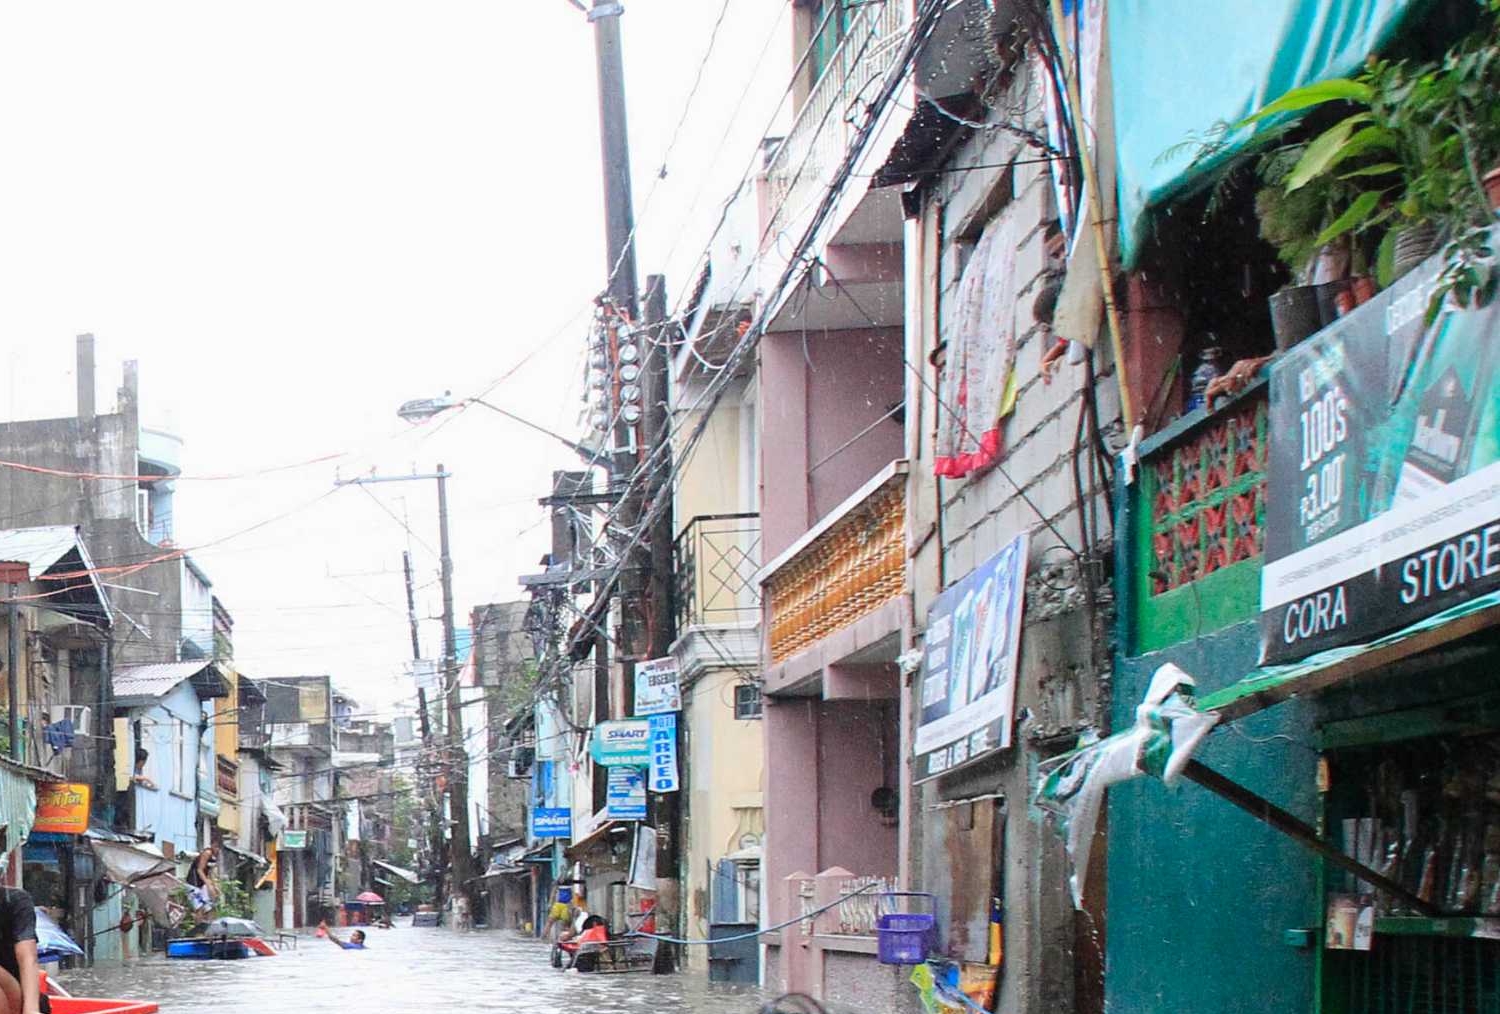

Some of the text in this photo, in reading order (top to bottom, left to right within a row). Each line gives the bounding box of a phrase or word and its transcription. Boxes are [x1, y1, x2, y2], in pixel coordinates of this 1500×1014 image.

[1284, 585, 1348, 644] CORA
[1400, 524, 1500, 605] STORE
[654, 730, 674, 790] ARCEO
